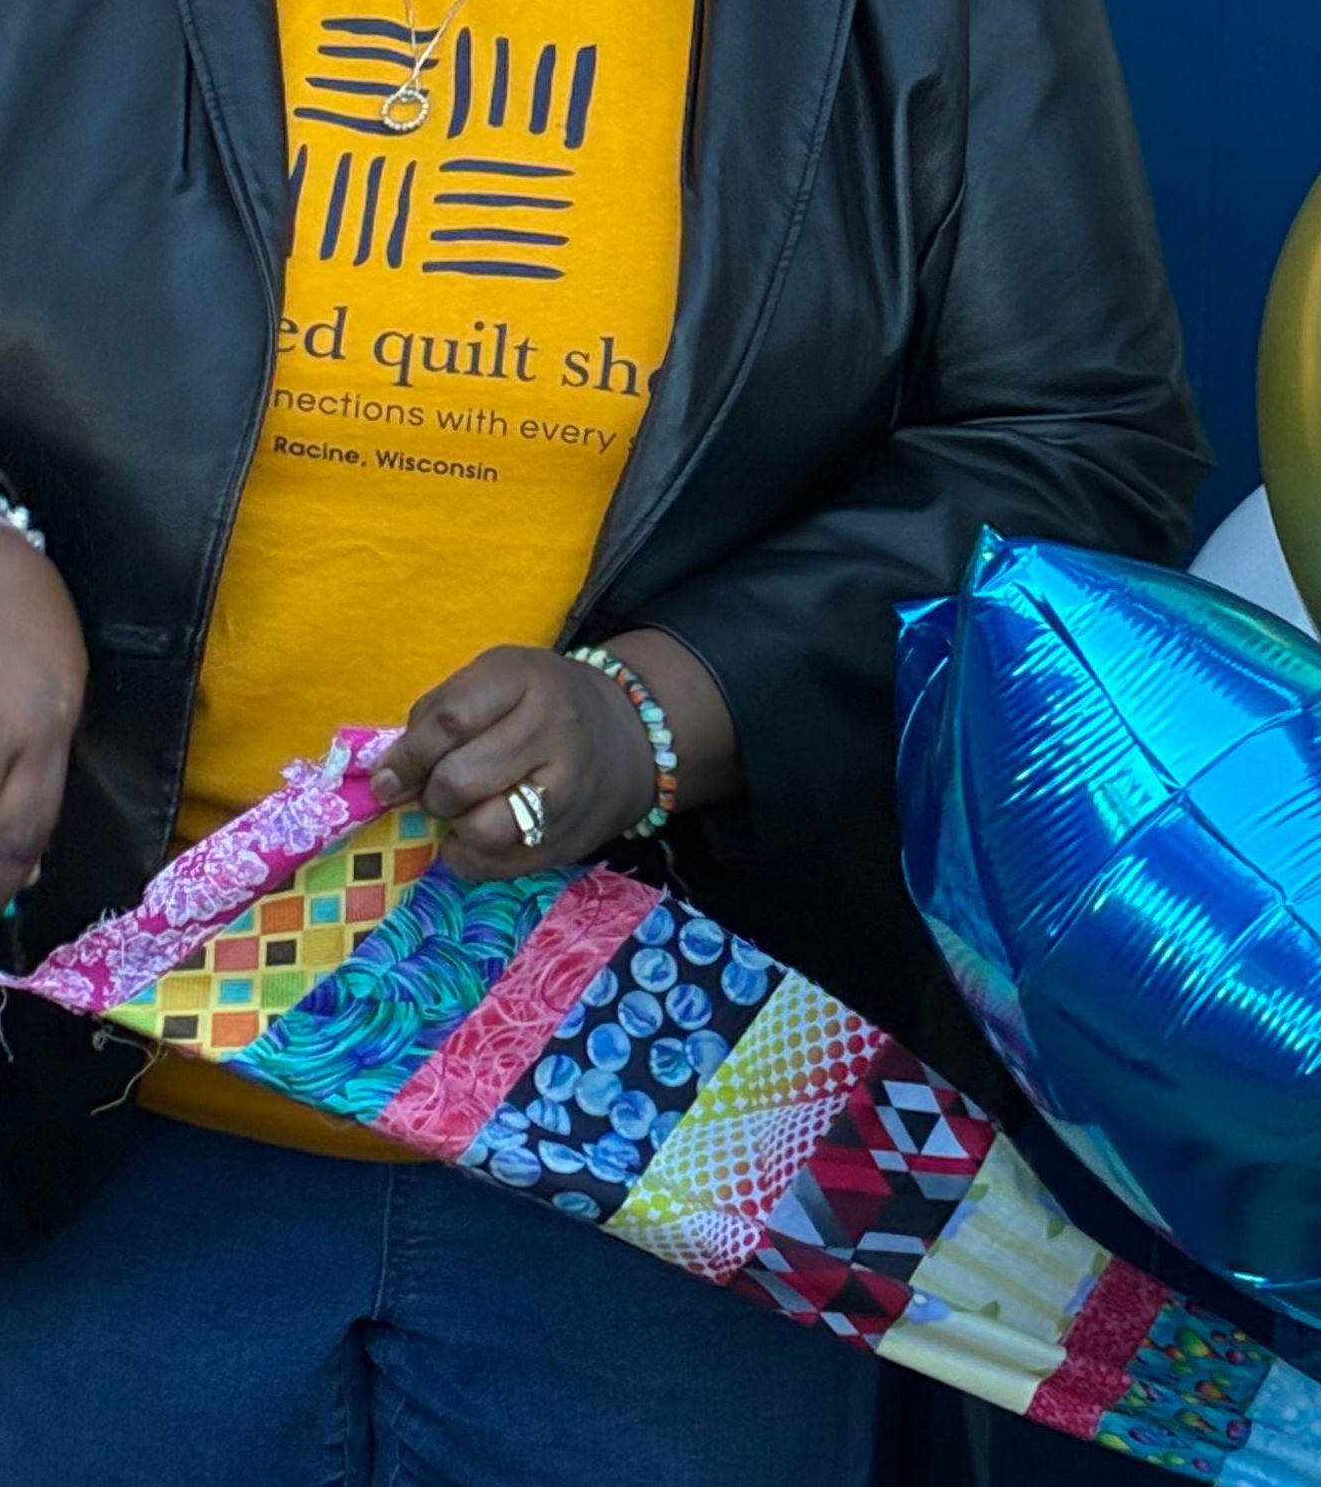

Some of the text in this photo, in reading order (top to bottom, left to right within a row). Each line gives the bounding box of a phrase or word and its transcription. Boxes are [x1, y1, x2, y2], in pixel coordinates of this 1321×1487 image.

[373, 321, 538, 388] quilt
[561, 336, 658, 397] sh
[437, 408, 507, 436] with
[520, 419, 617, 454] every
[274, 435, 498, 482] Racine, Wisconsin
